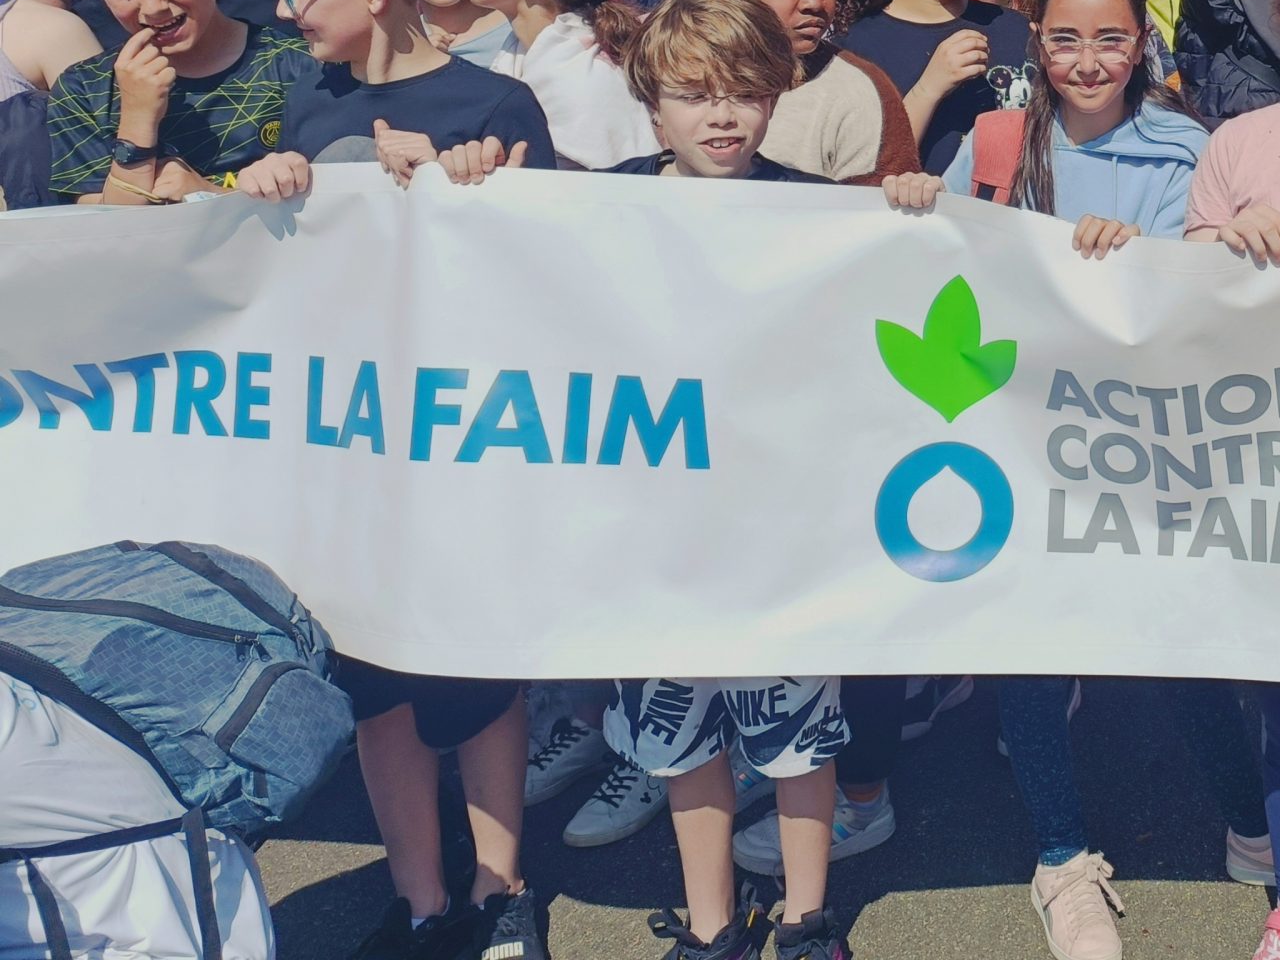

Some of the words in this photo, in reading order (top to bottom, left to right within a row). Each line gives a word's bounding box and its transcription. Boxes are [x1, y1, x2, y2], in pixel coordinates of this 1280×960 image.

[306, 356, 386, 454] LA
[408, 367, 711, 469] FAIM
[1046, 488, 1141, 556] LA
[638, 678, 694, 746] NIKE
[727, 683, 790, 728] NIKE
